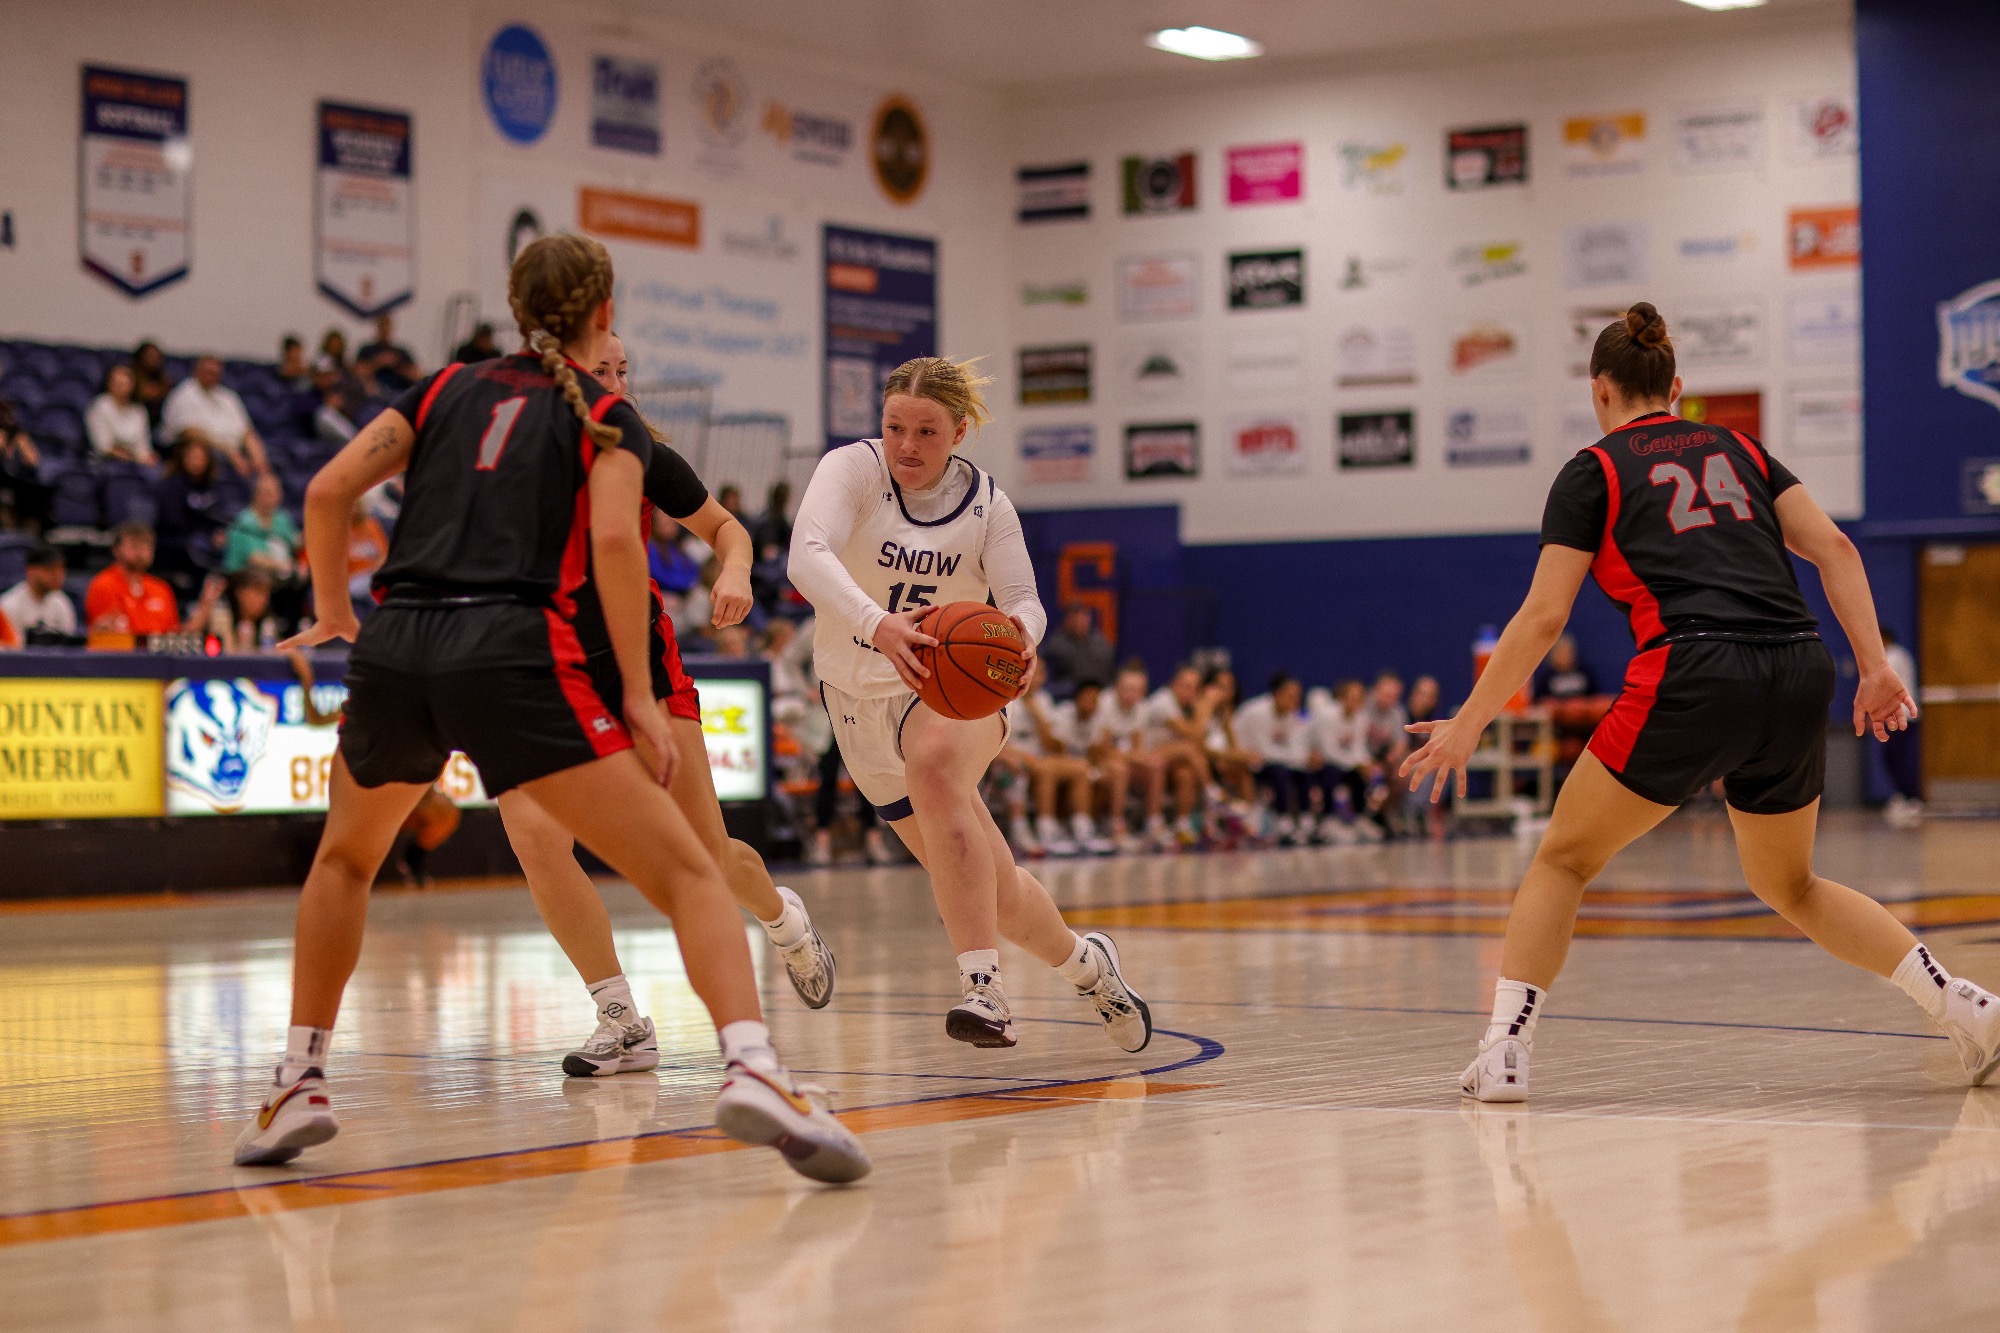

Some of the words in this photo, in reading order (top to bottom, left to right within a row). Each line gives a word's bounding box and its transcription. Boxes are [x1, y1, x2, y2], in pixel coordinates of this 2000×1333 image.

[475, 395, 528, 471] 1
[1629, 430, 1717, 457] Casper
[1648, 452, 1754, 535] 24
[878, 541, 962, 576] SNOW
[884, 582, 938, 614] 15
[0, 701, 146, 736] OUNTAIN
